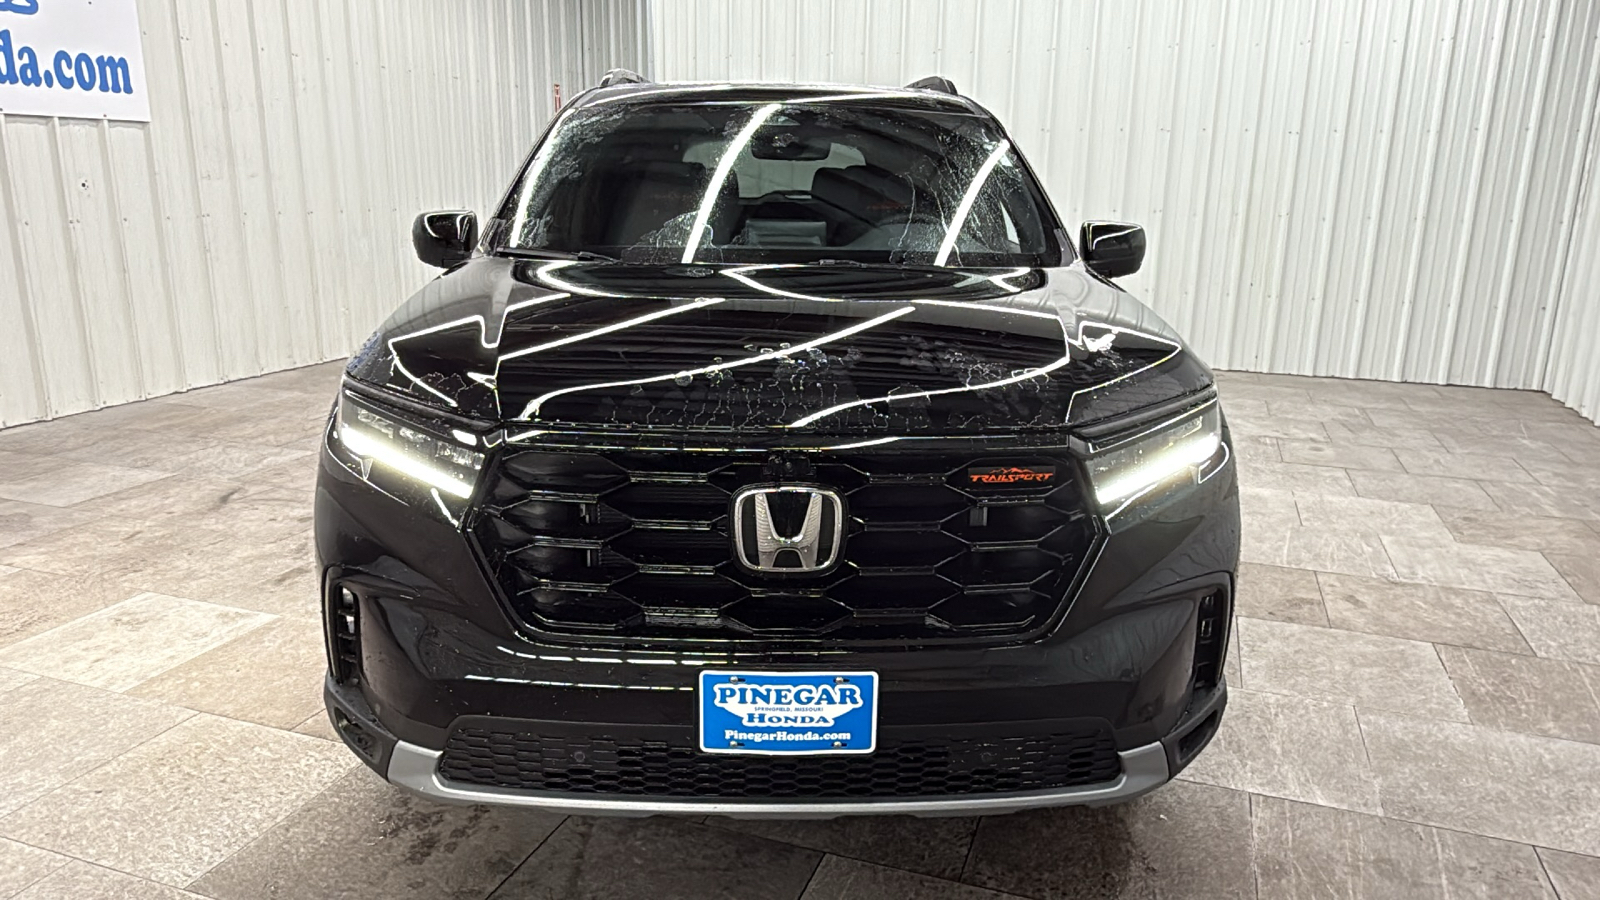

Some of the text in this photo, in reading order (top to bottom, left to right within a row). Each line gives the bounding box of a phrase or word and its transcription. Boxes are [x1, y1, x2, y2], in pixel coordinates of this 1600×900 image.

[718, 687, 859, 705] PINEGAR
[746, 713, 830, 723] HONDA
[724, 730, 851, 742] PinegarHonda.com
